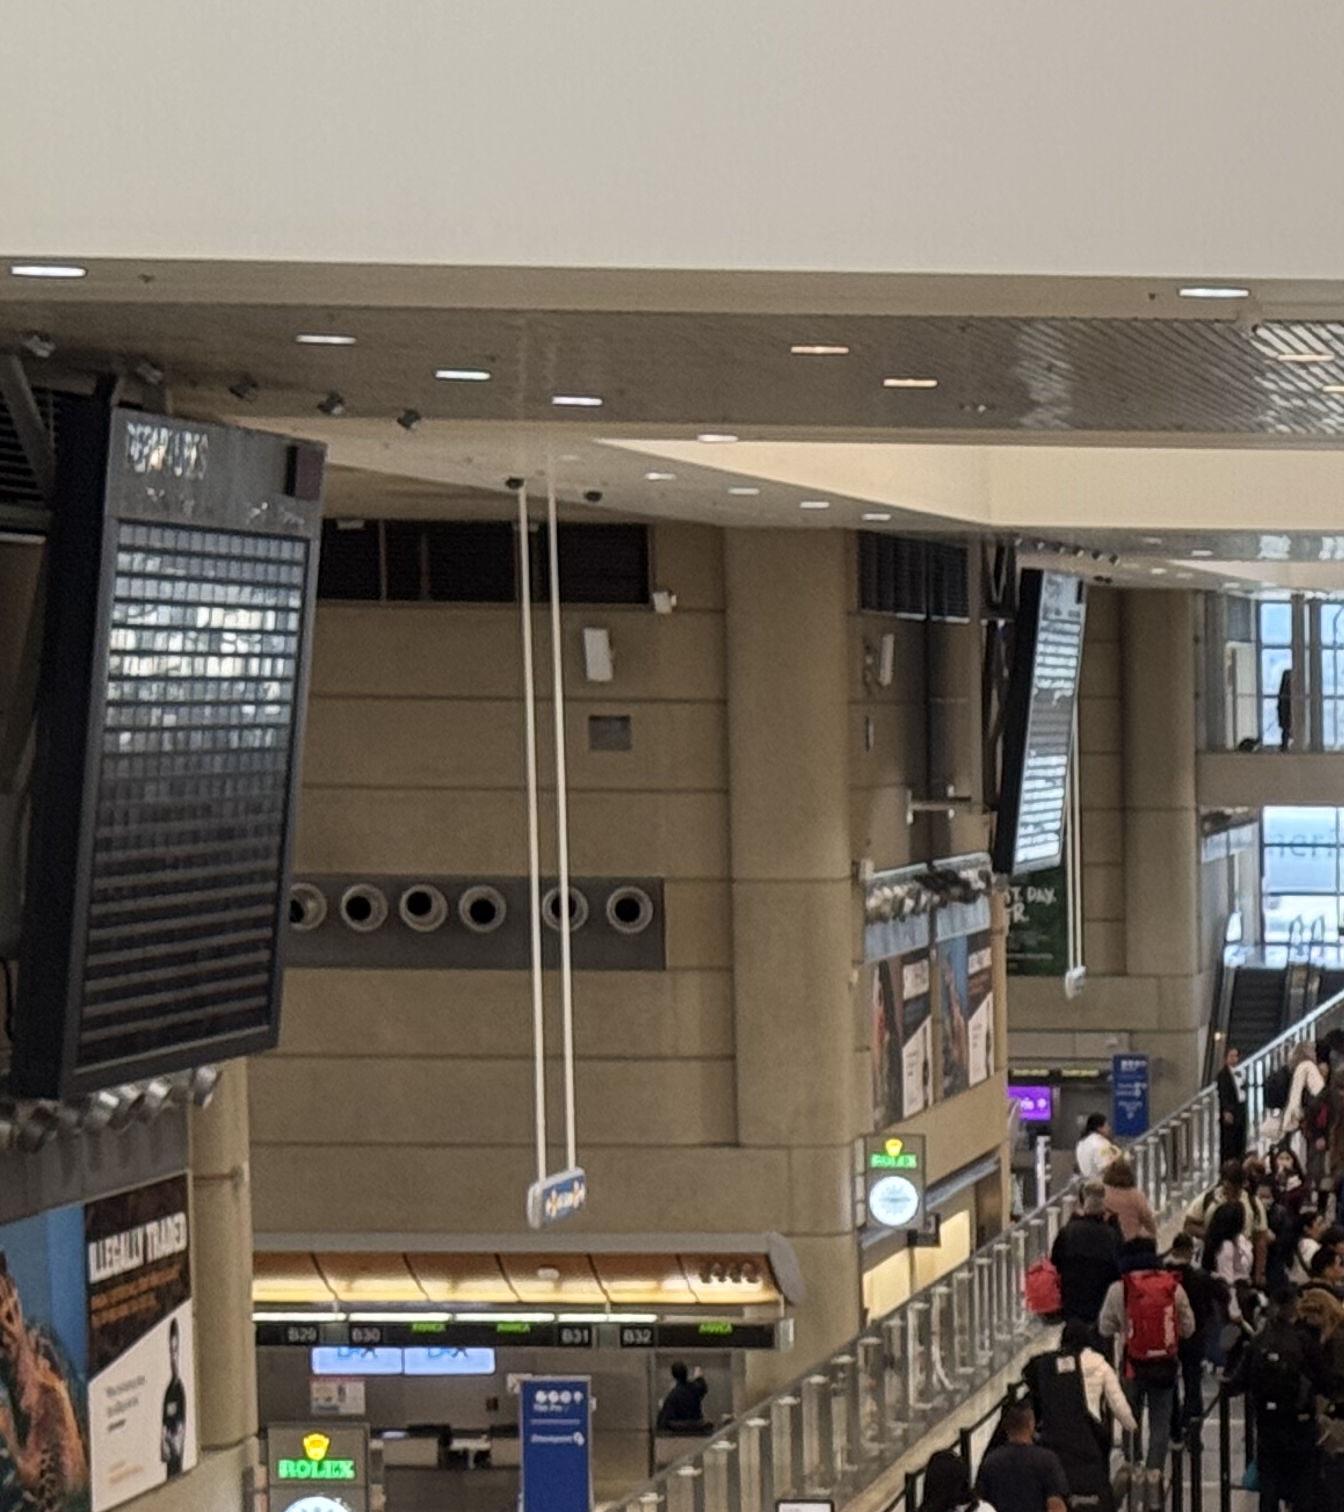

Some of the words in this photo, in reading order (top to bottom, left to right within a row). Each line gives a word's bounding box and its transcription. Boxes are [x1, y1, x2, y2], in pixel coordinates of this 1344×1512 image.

[89, 1227, 144, 1284] ILLEGALLY
[145, 1211, 187, 1265] TRADED
[287, 1327, 318, 1342] B29
[561, 1328, 590, 1344] B31
[623, 1328, 653, 1344] B32
[278, 1459, 356, 1479] ROLEX
